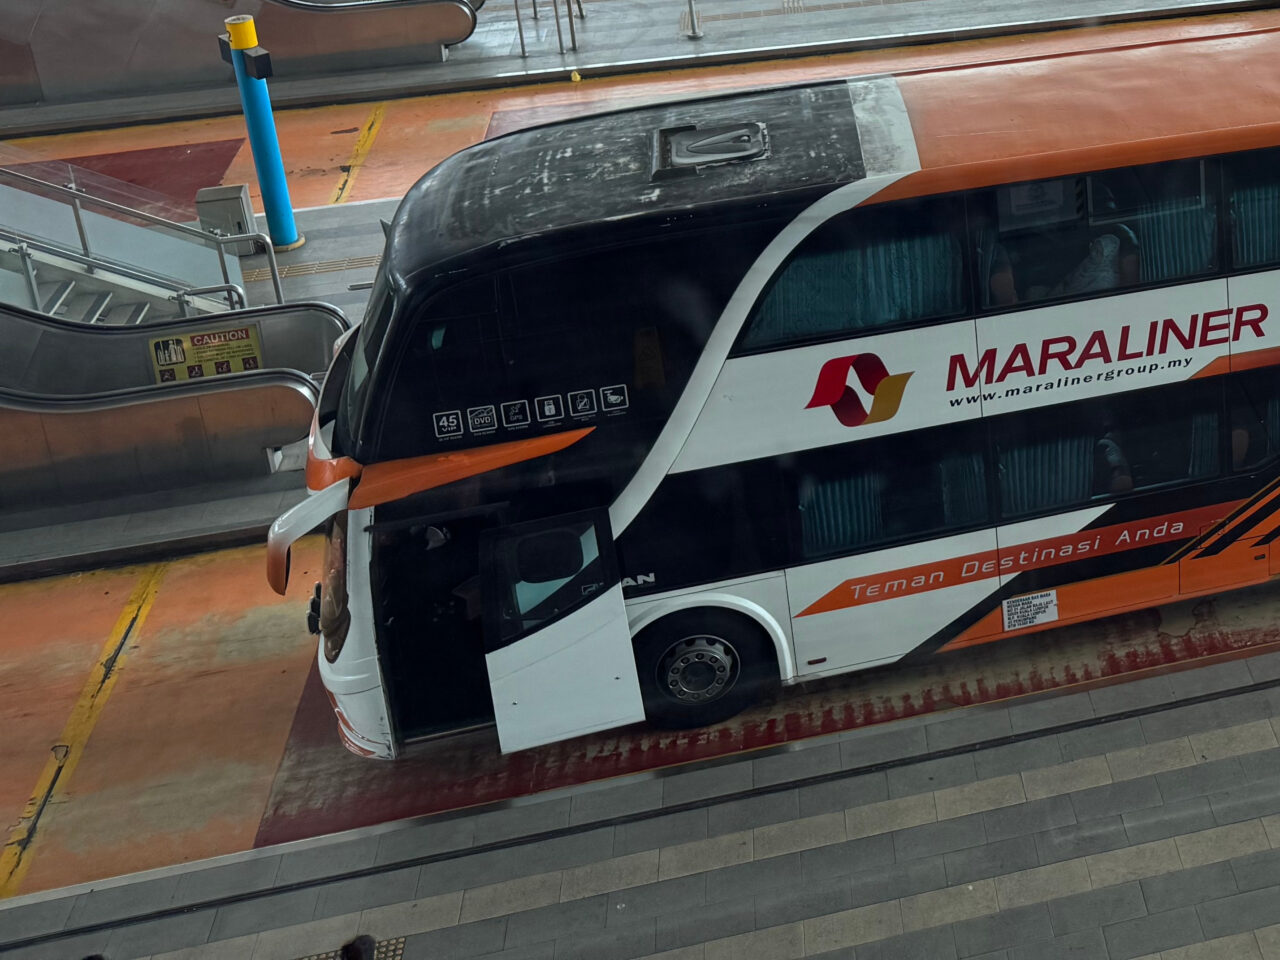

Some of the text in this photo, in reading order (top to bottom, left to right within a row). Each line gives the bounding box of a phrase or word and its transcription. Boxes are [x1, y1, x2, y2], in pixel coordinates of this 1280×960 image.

[194, 330, 247, 345] CAUTION
[946, 303, 1269, 391] MARALINER
[949, 357, 1193, 407] www.maralinergroup.my
[439, 415, 457, 428] 45
[474, 416, 491, 425] DVD
[850, 520, 1184, 600] Teman Destinasi Anda
